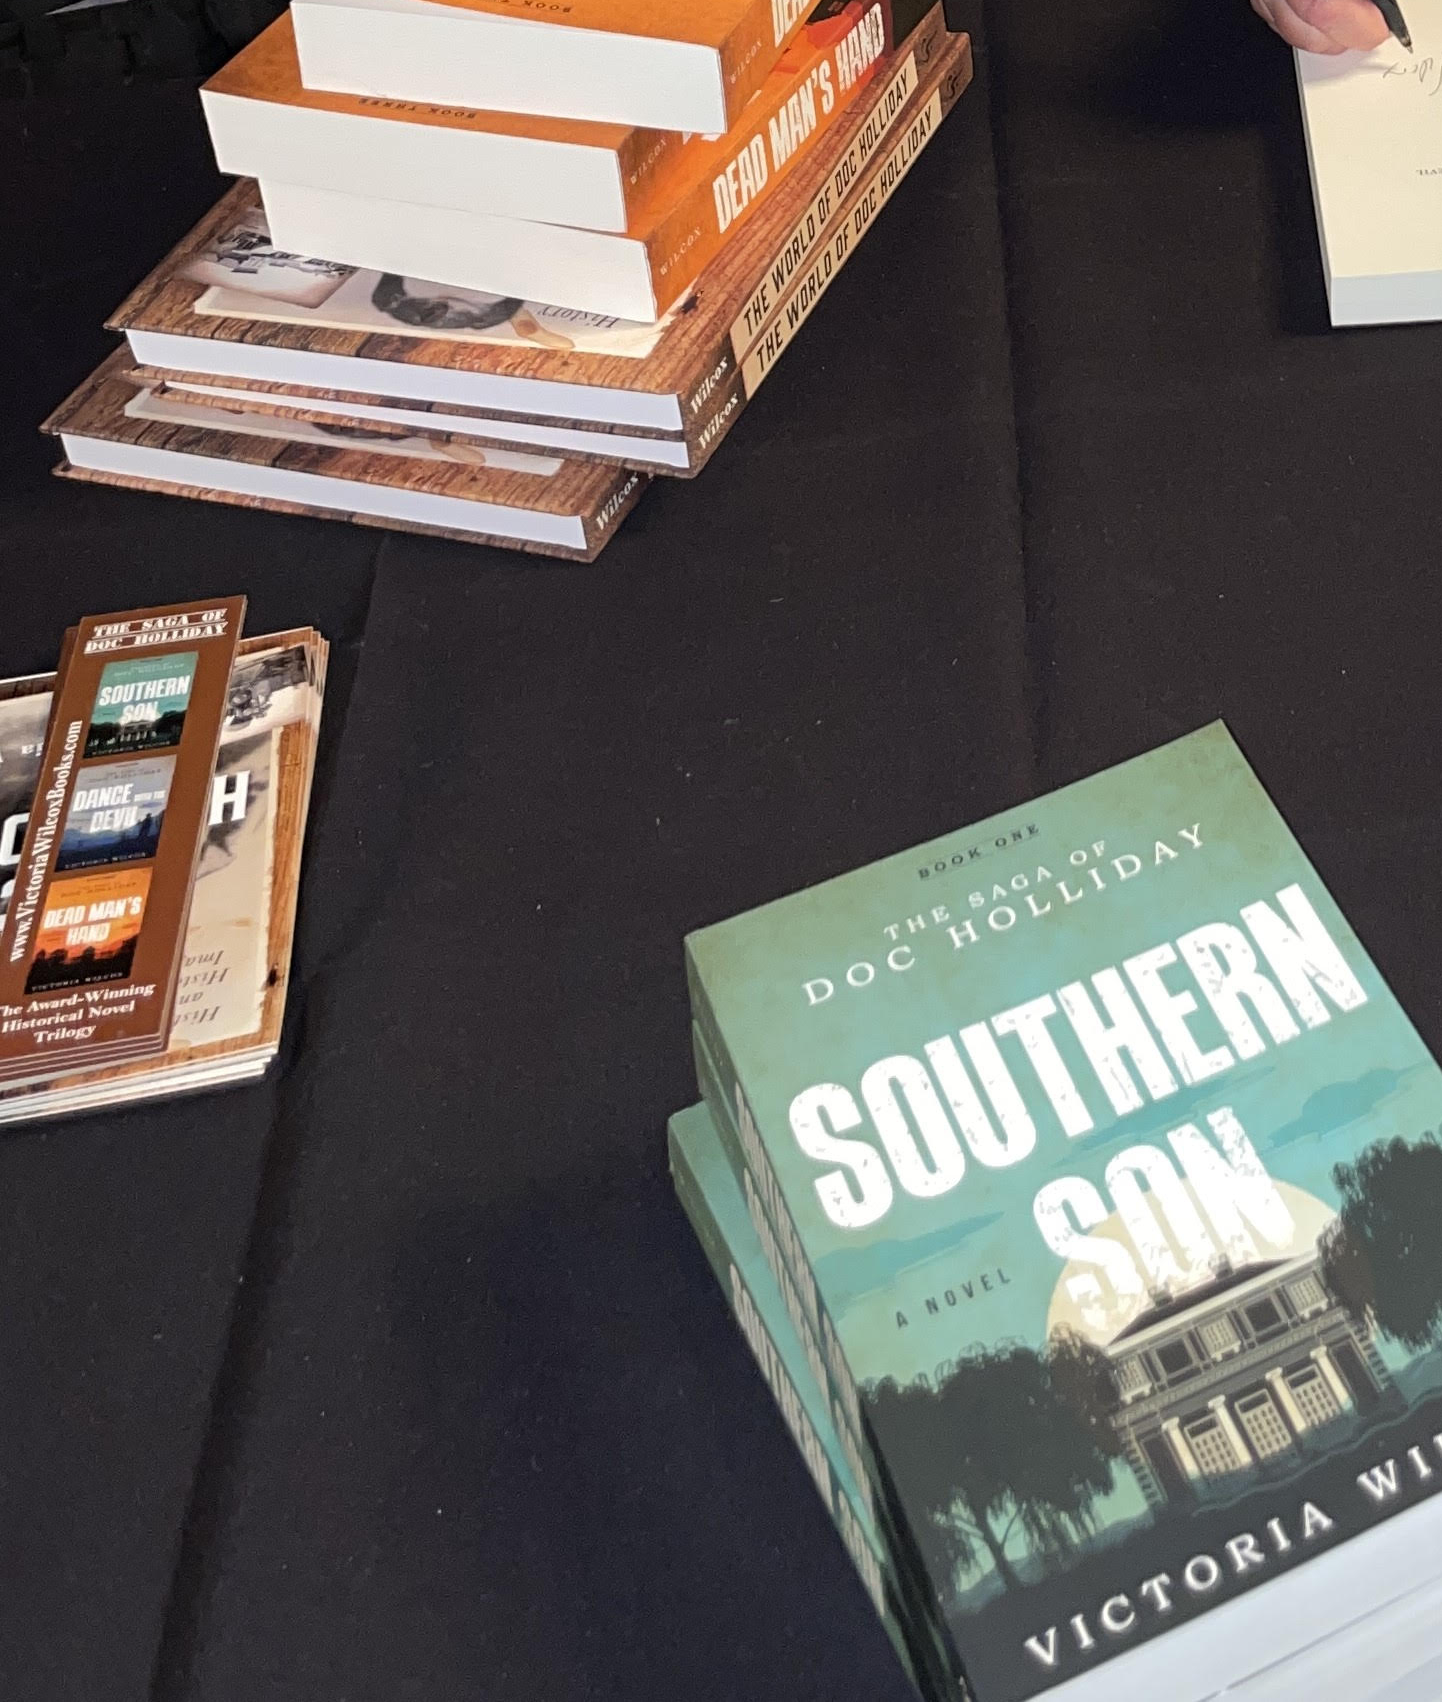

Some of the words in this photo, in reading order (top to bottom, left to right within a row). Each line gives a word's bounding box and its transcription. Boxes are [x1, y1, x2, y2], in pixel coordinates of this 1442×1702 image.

[713, 133, 768, 234] DEAD
[768, 60, 834, 172] MAN'S
[834, 2, 884, 92] HAND
[743, 284, 769, 336] THE
[772, 224, 814, 290] WORLD
[818, 194, 830, 224] OF
[835, 162, 857, 200] DOC
[859, 69, 908, 151] HOLLIDAY
[690, 356, 728, 414] Wilcox
[698, 393, 738, 450] Wilcox
[596, 472, 639, 531] Wilcox
[84, 638, 122, 654] DOC
[134, 623, 228, 646] HOLLIDAY
[94, 623, 130, 638] THE
[142, 615, 189, 630] SAGA
[202, 609, 227, 622] OF
[99, 675, 190, 706] SOUTHERN
[121, 701, 158, 725] SON
[10, 720, 82, 962] www.VictoriaWilcoxBooks.com
[916, 843, 981, 880] BOOK
[994, 821, 1041, 851] ONE
[802, 946, 918, 1007] DOC
[947, 821, 1207, 951] HOLLIDAY
[882, 905, 950, 942] THE
[967, 865, 1054, 911] SAGA
[1069, 840, 1111, 865] OF
[2, 1011, 82, 1034] Historical
[89, 1000, 135, 1019] Novel
[26, 983, 155, 1014] Award-Winning
[34, 1024, 96, 1044] Trilogy
[788, 883, 1369, 1230] SOUTHERN
[1032, 1104, 1296, 1333] SON
[893, 1311, 910, 1330] A
[924, 1267, 1014, 1319] NOVEL
[1023, 1498, 1335, 1669] VICTORIA
